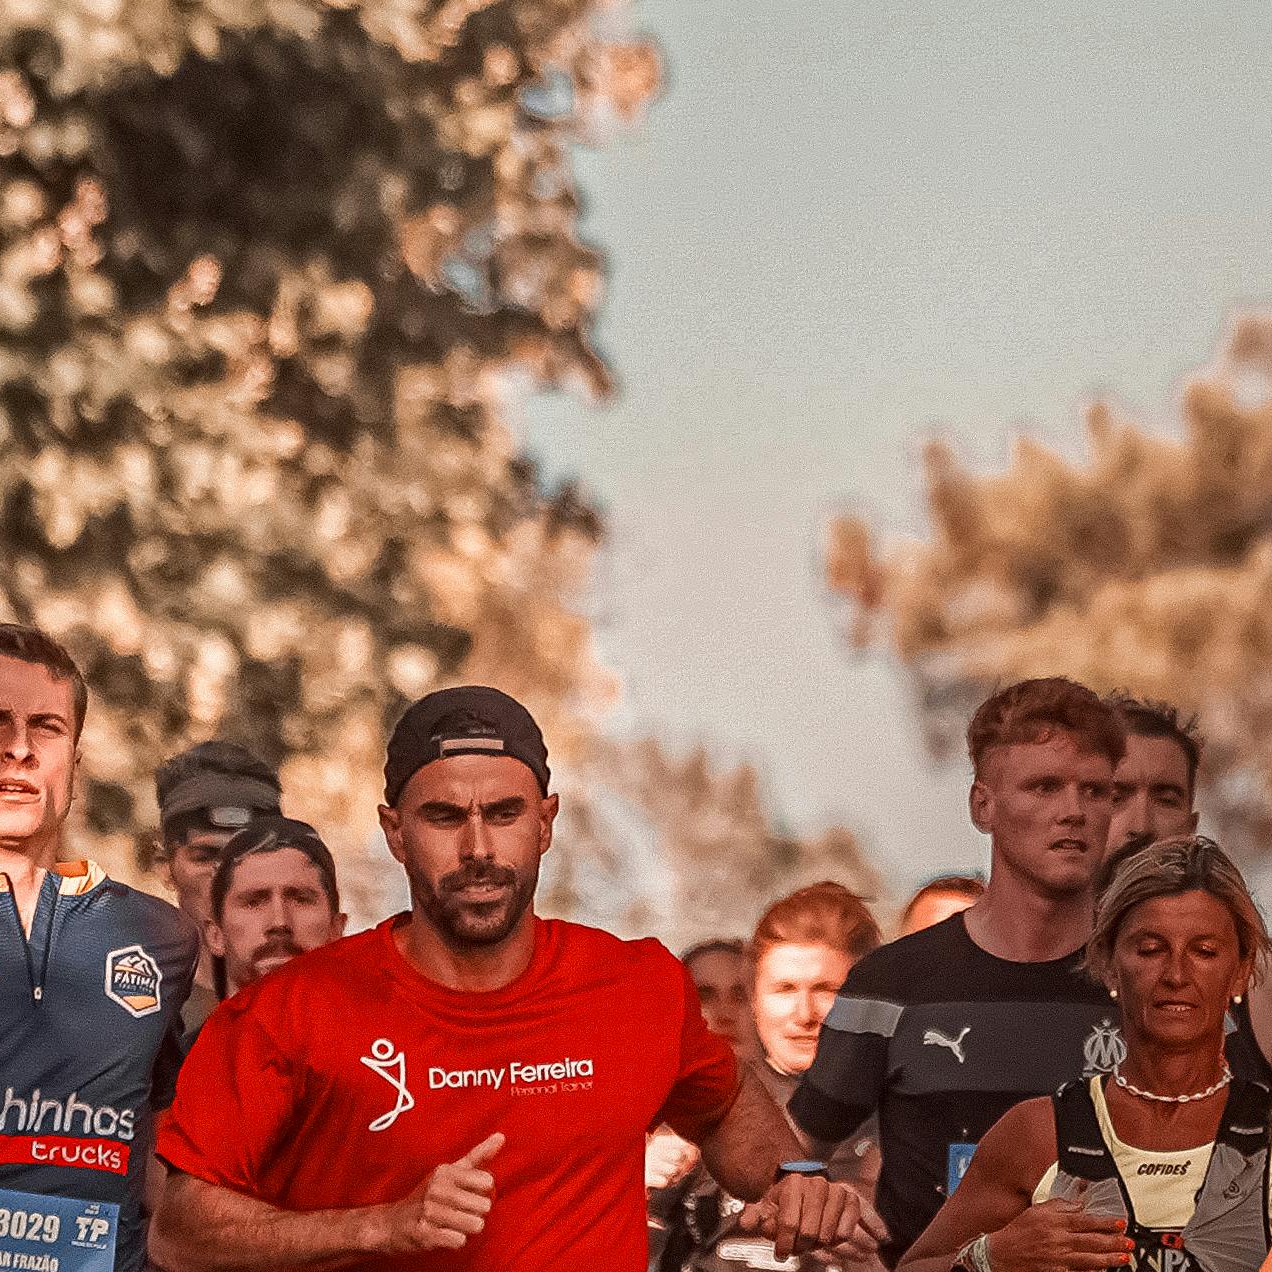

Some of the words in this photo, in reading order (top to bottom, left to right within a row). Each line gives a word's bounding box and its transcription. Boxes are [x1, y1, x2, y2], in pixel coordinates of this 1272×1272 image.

[428, 1067, 506, 1090] Danny
[510, 1057, 593, 1084] Ferreira
[31, 1140, 122, 1169] trucks
[1137, 1161, 1190, 1176] COFIDES
[76, 1217, 109, 1243] TP
